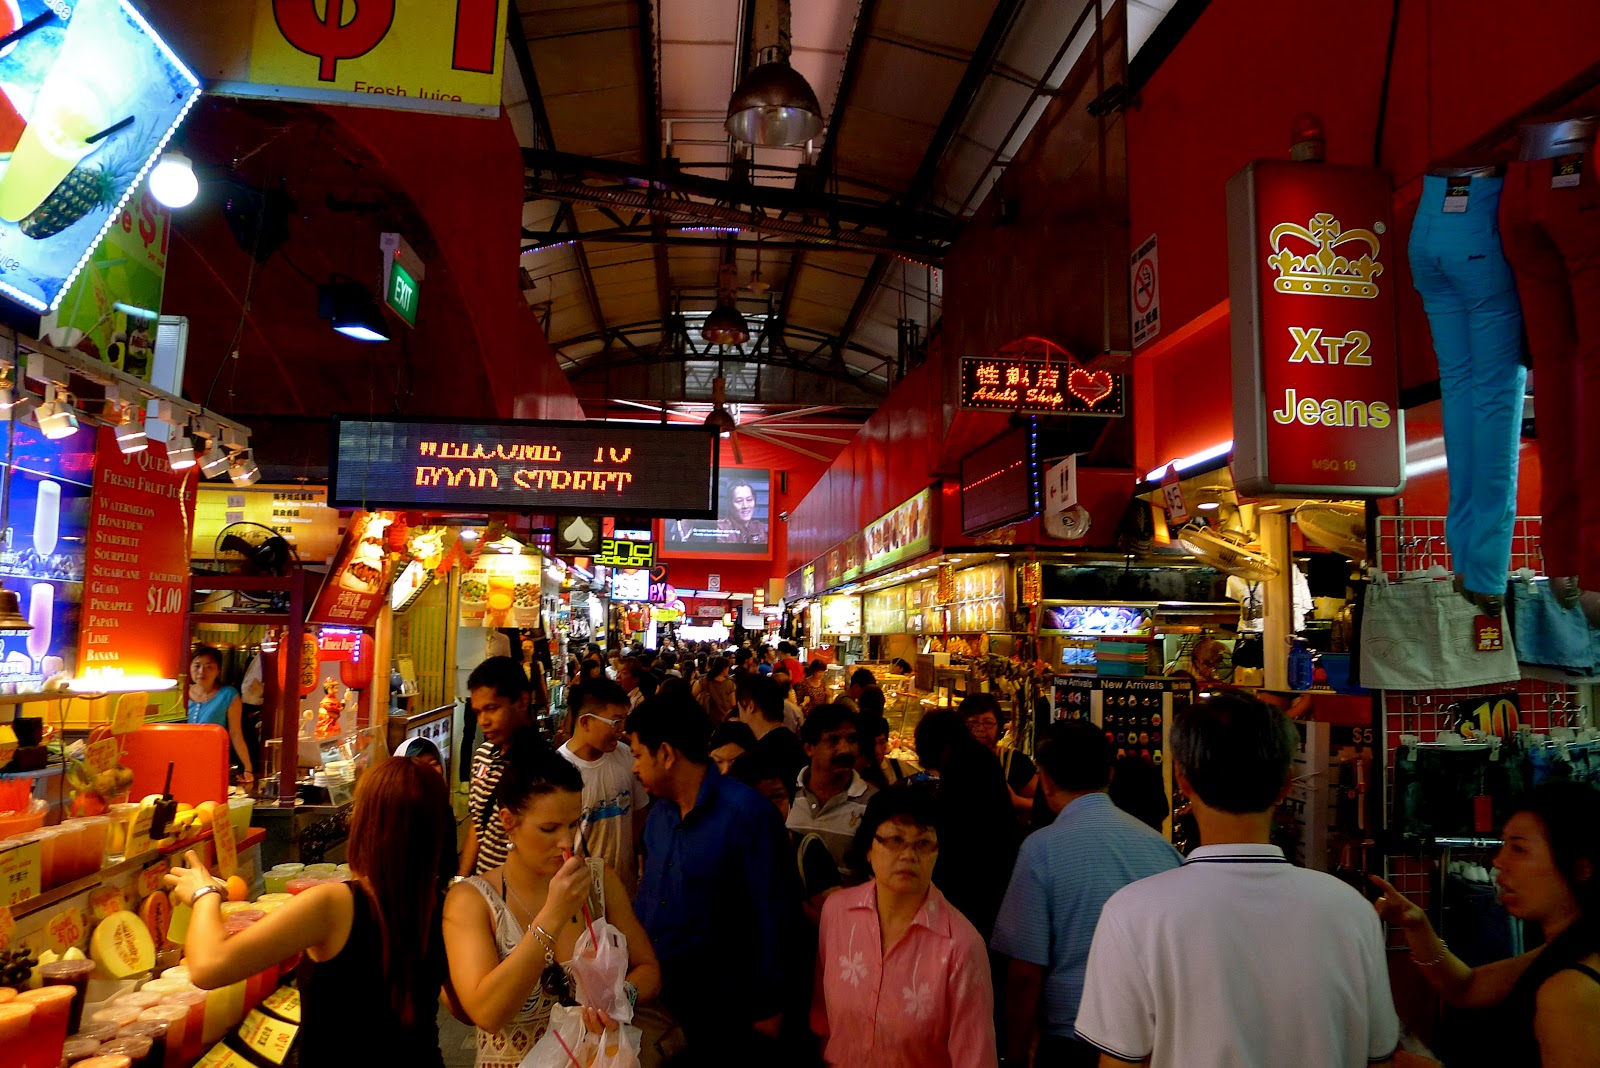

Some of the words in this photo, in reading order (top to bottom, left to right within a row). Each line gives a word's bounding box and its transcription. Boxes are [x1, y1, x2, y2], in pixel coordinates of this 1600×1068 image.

[394, 275, 412, 312] EXIT
[971, 386, 1018, 402] Adult
[1025, 388, 1064, 407] Shop
[1272, 388, 1392, 429] Jeans
[1312, 459, 1340, 471] MSQ
[1343, 460, 1357, 471] 19
[103, 468, 136, 490] FRESH
[138, 476, 166, 496] FRUIT
[100, 496, 155, 518] WATERMELON
[97, 513, 144, 532] HONEYDEW
[96, 530, 140, 547] STARFRUIT
[94, 546, 139, 564] SOURPLUM
[601, 540, 653, 558] 2nd
[92, 563, 141, 580] SUGARCANE
[91, 580, 120, 595] GUAVA
[90, 597, 134, 612] PINEAPPLE
[146, 583, 182, 617] $1.00
[88, 614, 119, 628] PAPAYA
[87, 631, 110, 645] LIME
[86, 648, 119, 662] BANANA
[1053, 677, 1068, 686] New
[1069, 679, 1093, 688] Arrivals
[1100, 680, 1122, 690] New
[1125, 681, 1164, 690] Arrivals
[1460, 699, 1519, 744] $10
[1352, 727, 1373, 745] $5
